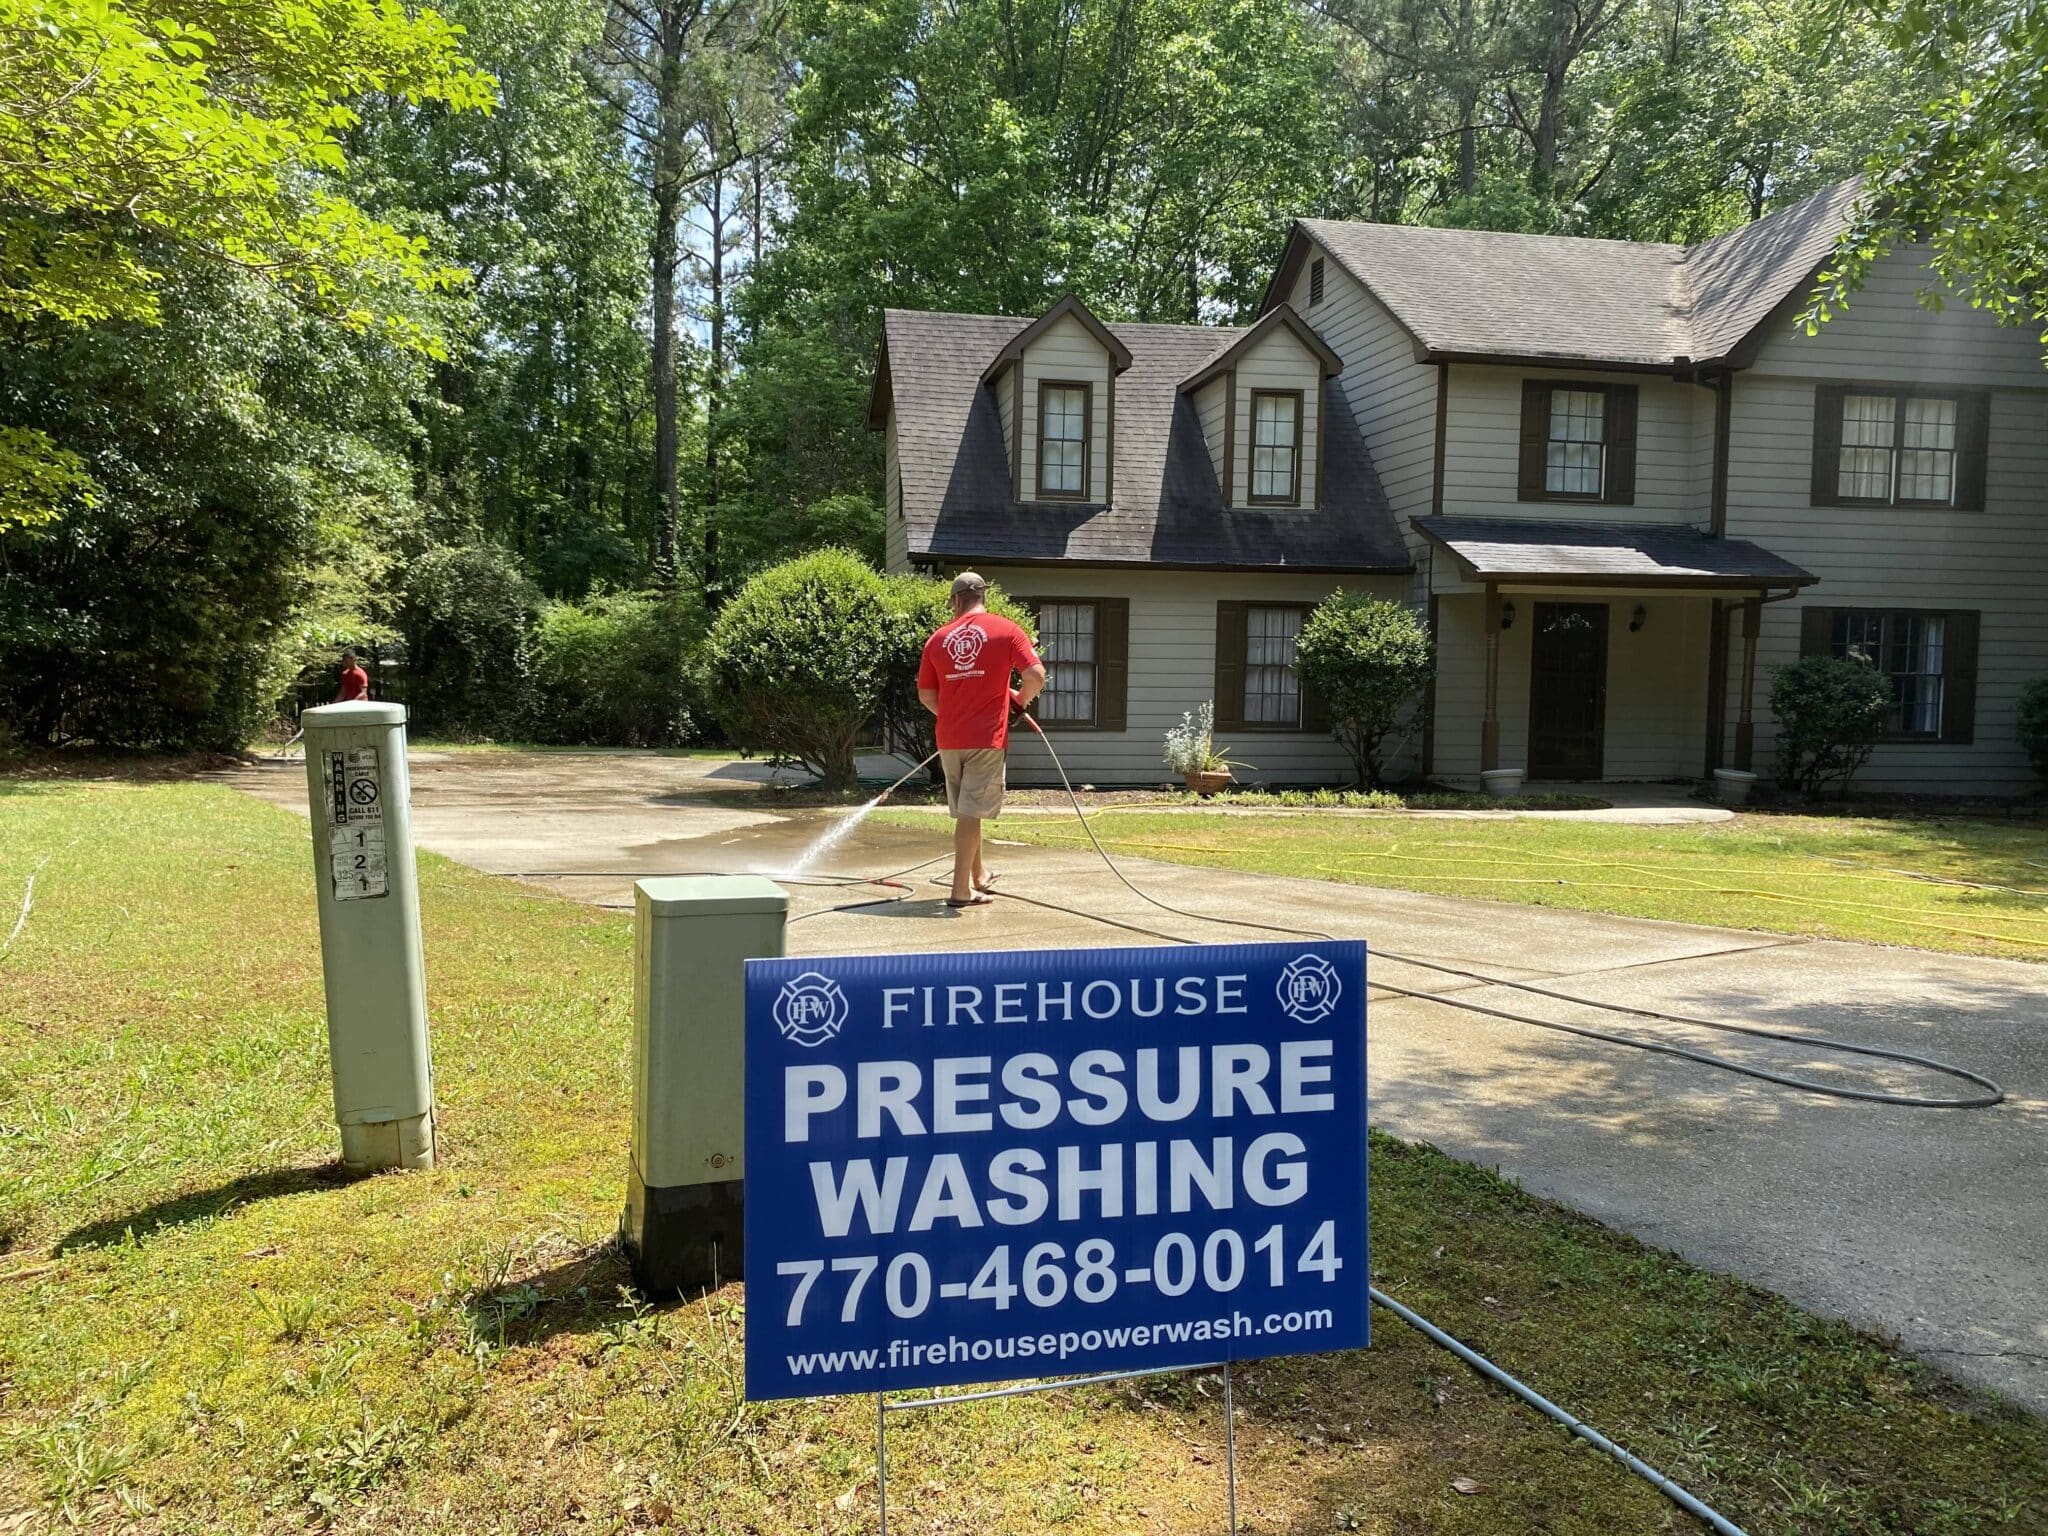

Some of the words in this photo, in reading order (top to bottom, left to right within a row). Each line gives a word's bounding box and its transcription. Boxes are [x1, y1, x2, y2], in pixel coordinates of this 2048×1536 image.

[333, 752, 347, 823] WARNING
[354, 855, 366, 869] 2
[355, 831, 364, 848] 1
[882, 973, 1248, 1029] FIREHOUSE
[785, 1039, 1335, 1143] PRESSURE
[809, 1132, 1308, 1238] WASHING
[777, 1220, 1343, 1327] 770-468-0014
[787, 1309, 1333, 1376] www.firehousepowerwash.com
